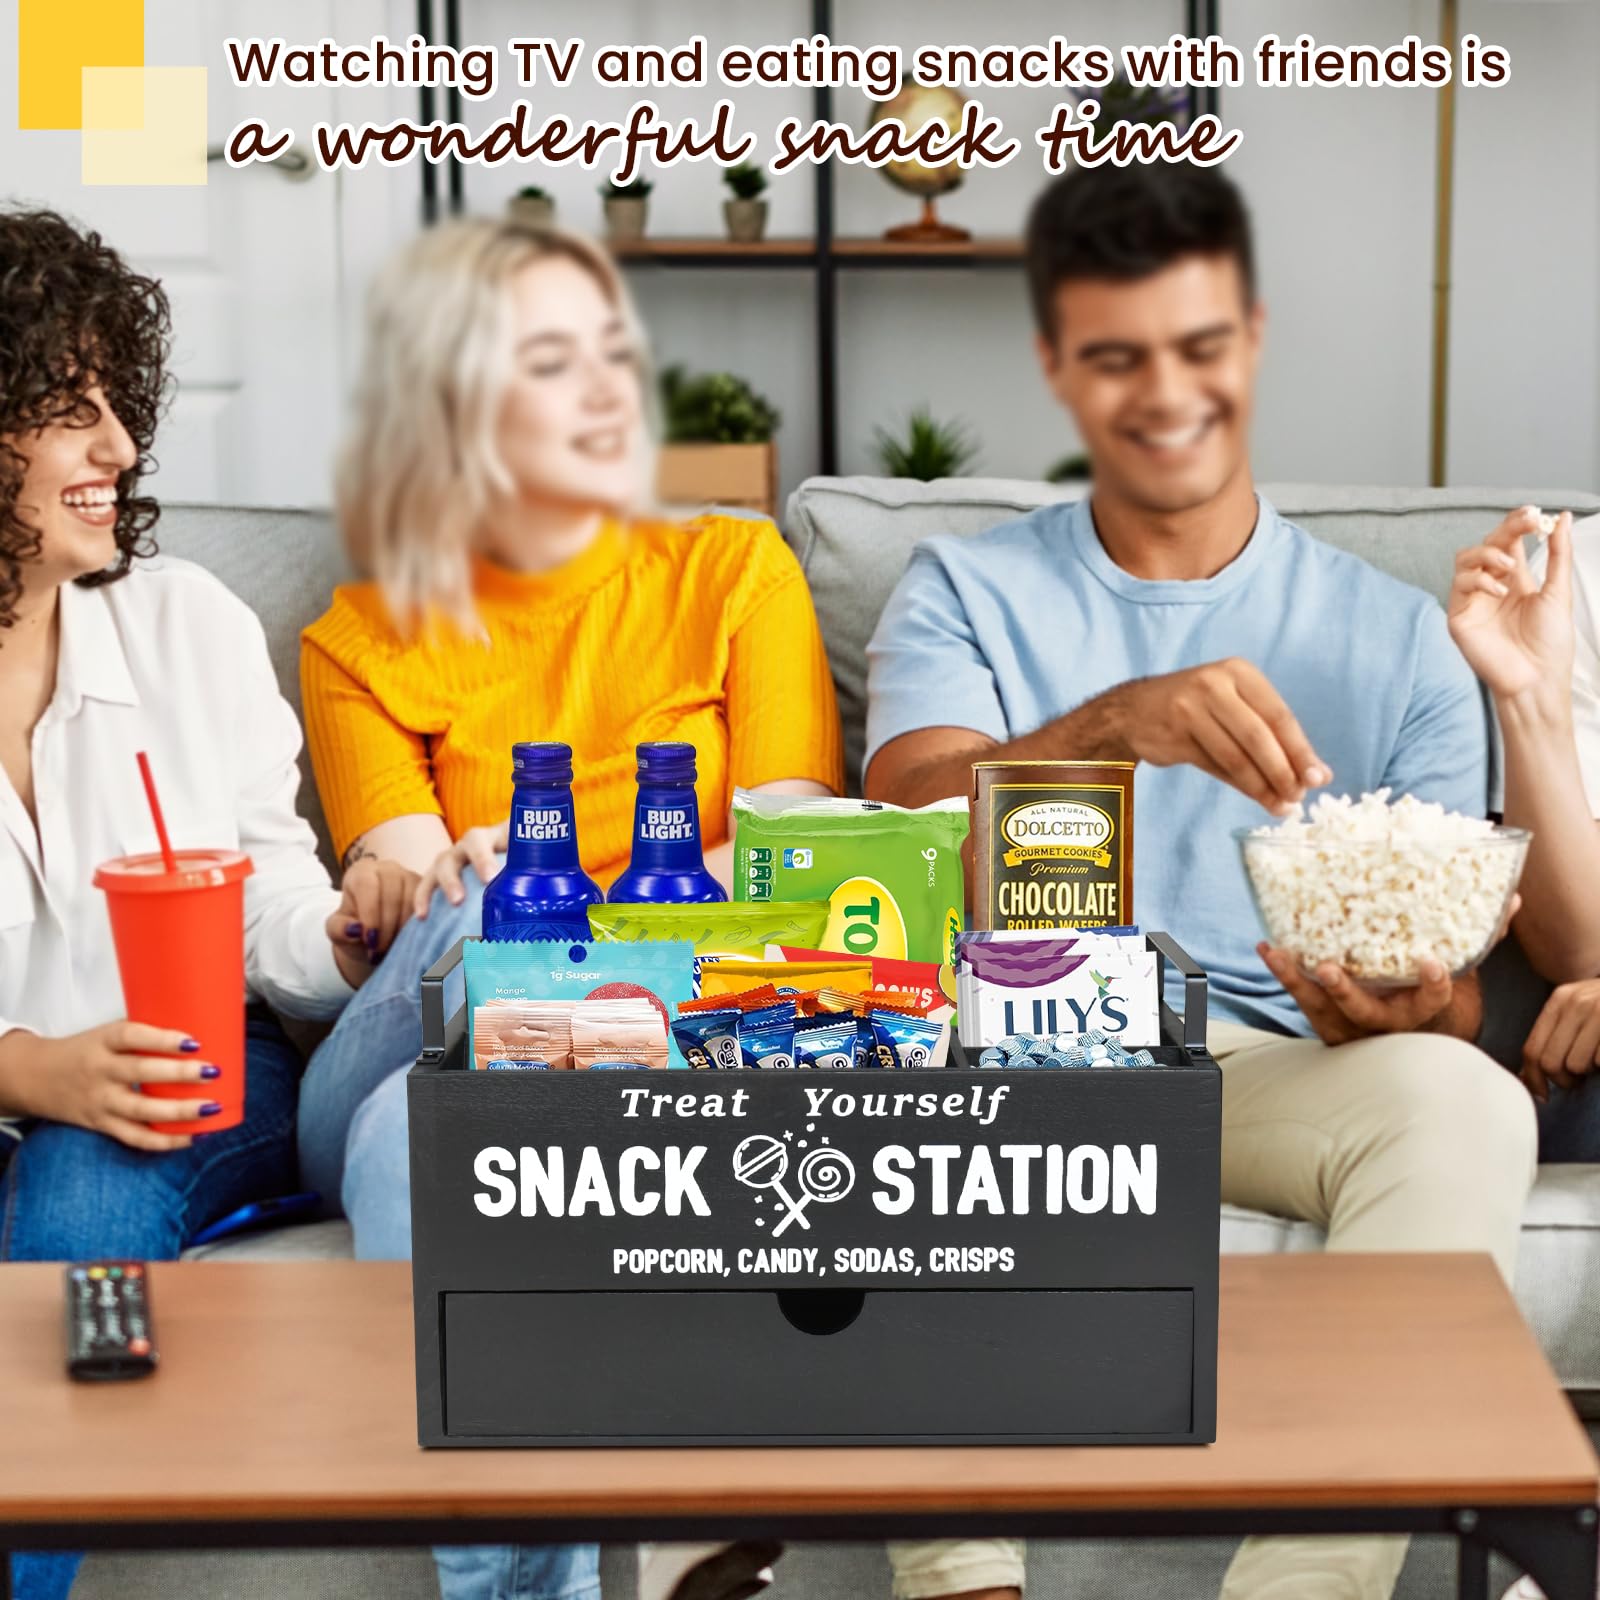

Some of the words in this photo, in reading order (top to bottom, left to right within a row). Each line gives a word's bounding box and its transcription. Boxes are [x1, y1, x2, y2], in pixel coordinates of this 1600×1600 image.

[523, 810, 562, 825] BUD
[647, 810, 686, 825] BUD
[1050, 807, 1089, 817] NATURAL
[1014, 819, 1105, 837] DOLCETTO
[921, 847, 938, 861] 9
[1014, 848, 1061, 858] GOURMET
[1063, 848, 1103, 859] COOKIES
[1029, 862, 1089, 877] Premium
[998, 881, 1117, 917] CHOCOLATE
[550, 970, 563, 981] 1g
[565, 970, 601, 981] Sugar
[495, 987, 526, 996] Mango
[620, 1088, 750, 1118] Treat
[803, 1085, 1010, 1126] Yourself
[473, 1145, 712, 1218] SNACK
[871, 1143, 1158, 1216] STATION
[613, 1248, 731, 1278] POPCORN,
[737, 1247, 826, 1278] CANDY,
[833, 1247, 922, 1277] SODAS,
[929, 1246, 1015, 1273] CRISPS
